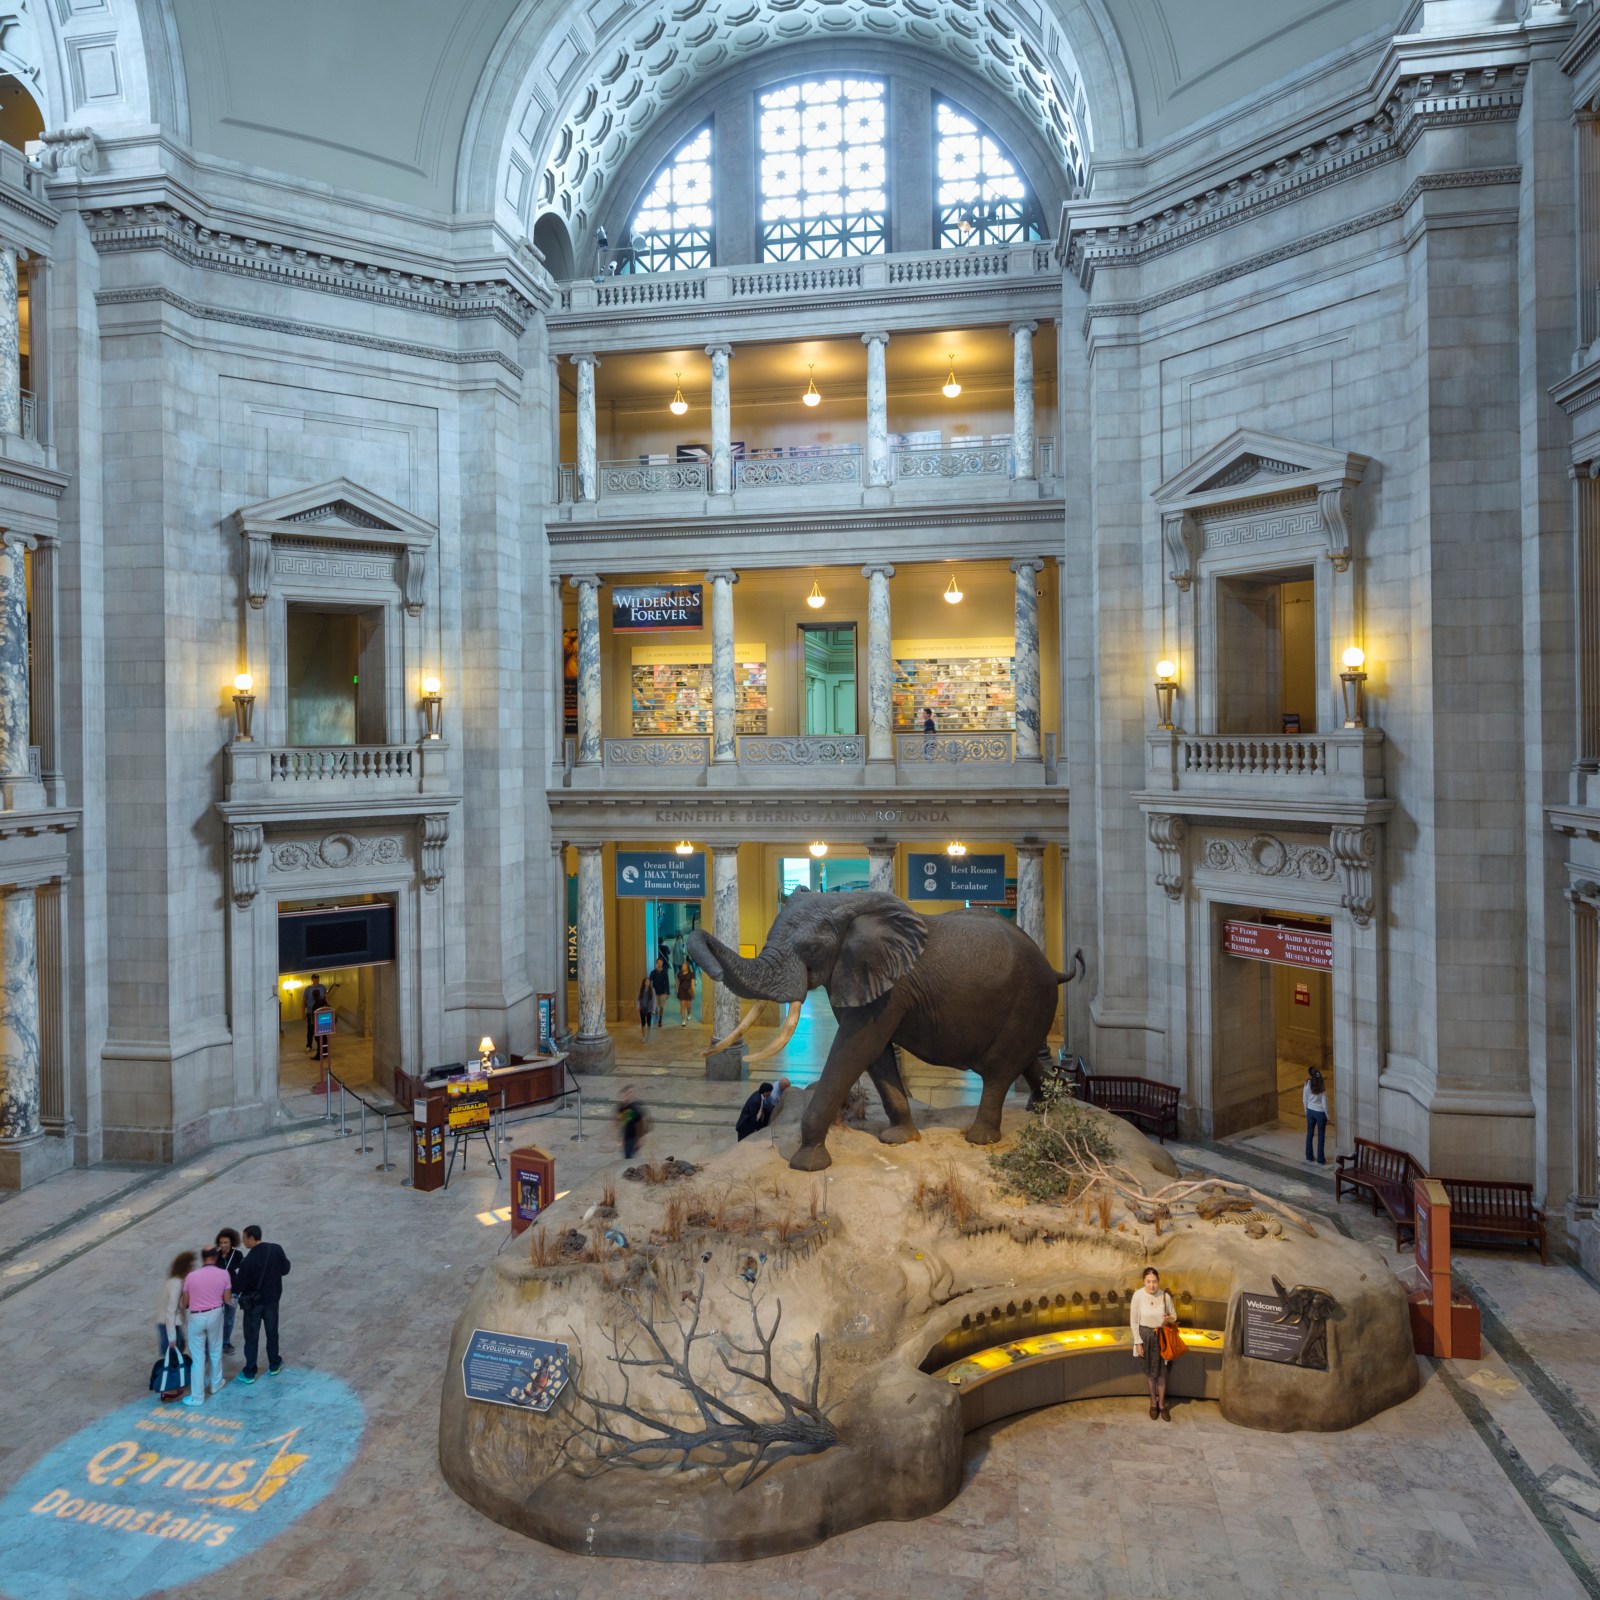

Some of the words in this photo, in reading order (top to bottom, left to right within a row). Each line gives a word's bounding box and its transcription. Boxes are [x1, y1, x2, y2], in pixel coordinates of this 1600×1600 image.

[616, 593, 700, 608] WILDERNESS
[631, 608, 688, 621] FOREVER
[655, 811, 722, 822] KENNETH
[746, 811, 811, 822] BEHRING
[818, 811, 868, 822] FAMILY
[875, 811, 950, 822] ROTUNDA
[644, 861, 667, 869] Ocean
[668, 861, 685, 869] Hall
[951, 865, 968, 874] Rest
[970, 865, 997, 874] Rooms
[671, 870, 700, 879] Theater
[644, 880, 671, 889] Human
[673, 881, 700, 891] Origins
[951, 881, 989, 890] Escalator
[1239, 927, 1258, 937] FLOOR
[568, 925, 577, 961] IMAX
[1231, 934, 1257, 945] EXHIBITS
[1284, 933, 1303, 943] BAIRD
[1303, 936, 1333, 947] AUDITORI
[1231, 942, 1263, 954] RESTROOMS
[1285, 943, 1308, 953] ATRIUM
[1284, 951, 1310, 962] MUSEUM
[1311, 955, 1328, 965] SHOP
[450, 1101, 488, 1113] JERUSALEM
[1246, 1300, 1282, 1312] Welcome
[481, 1344, 516, 1355] EVOLUTION
[516, 1349, 534, 1358] TRAIL
[29, 1488, 235, 1548] Downstairs
